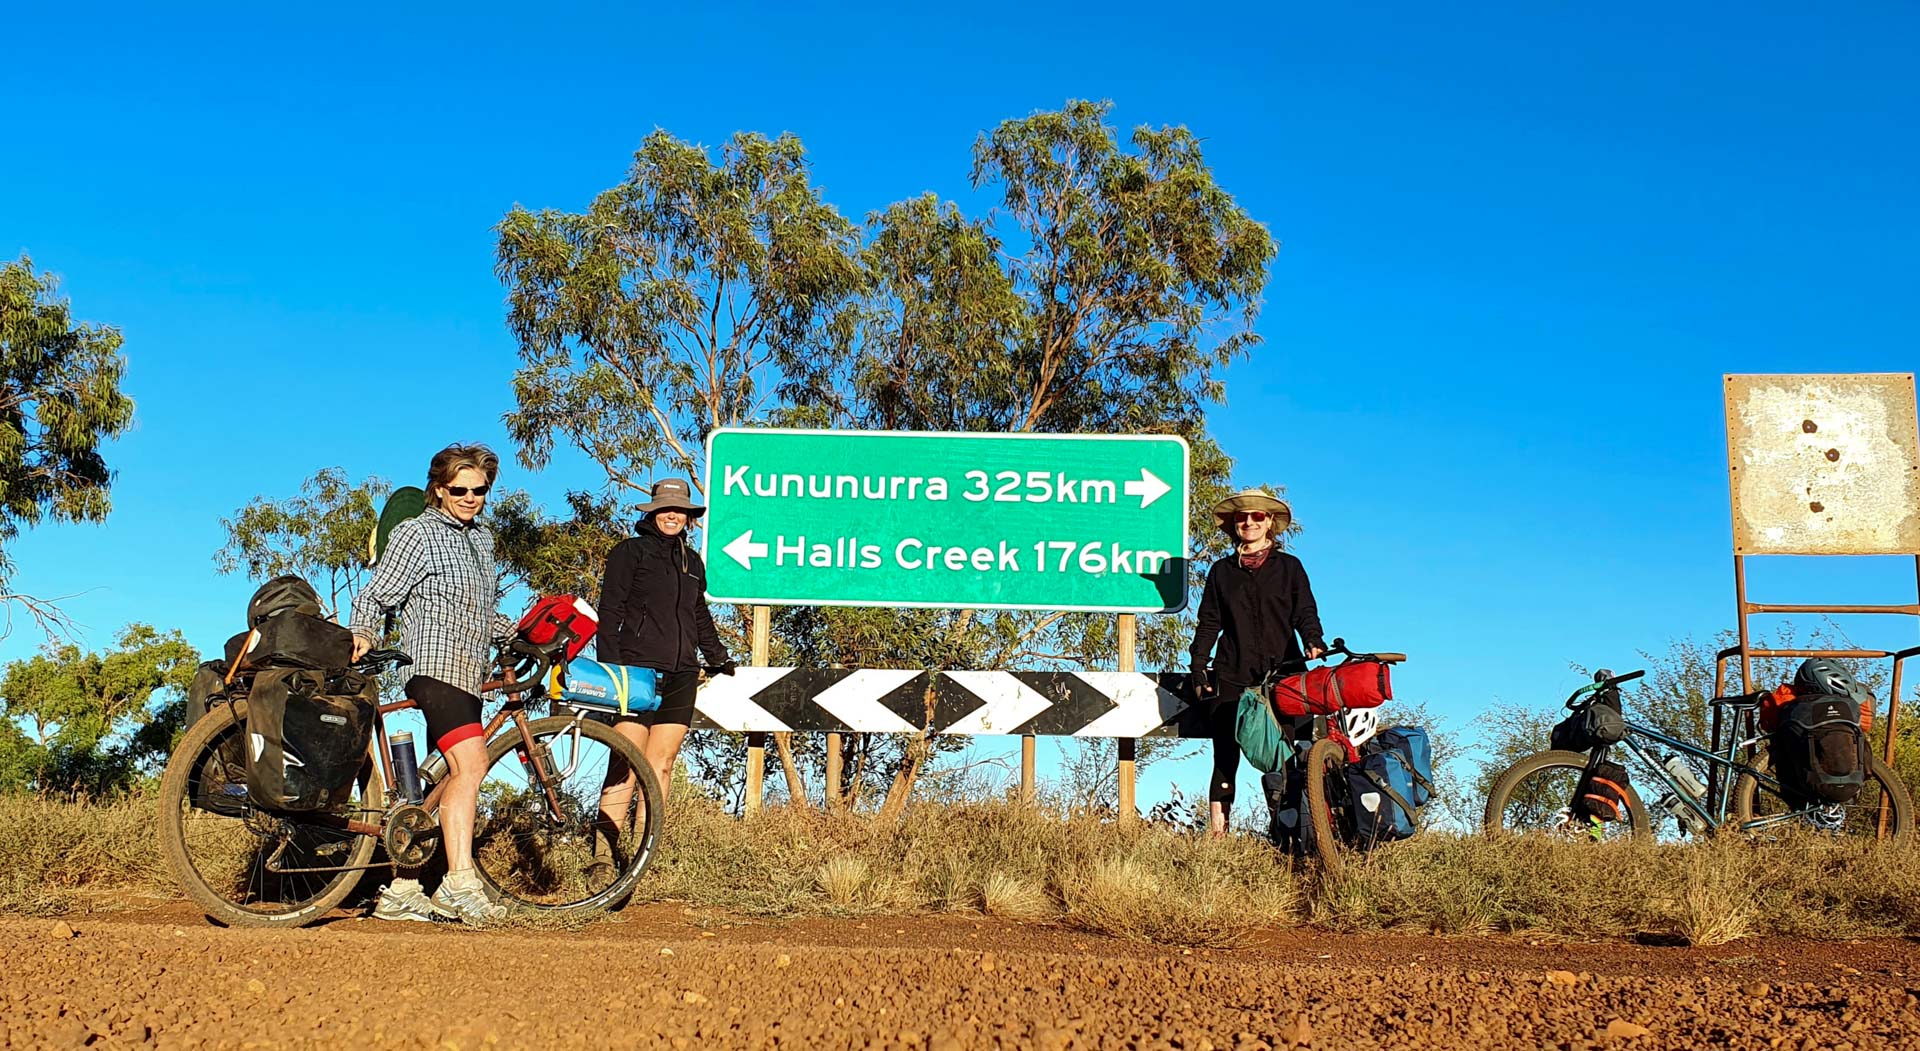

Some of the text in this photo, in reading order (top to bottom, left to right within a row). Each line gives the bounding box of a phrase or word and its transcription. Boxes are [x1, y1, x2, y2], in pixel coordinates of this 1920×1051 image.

[723, 465, 1117, 504] Kununurra 325km
[776, 535, 1172, 575] Halls Creek 176km
